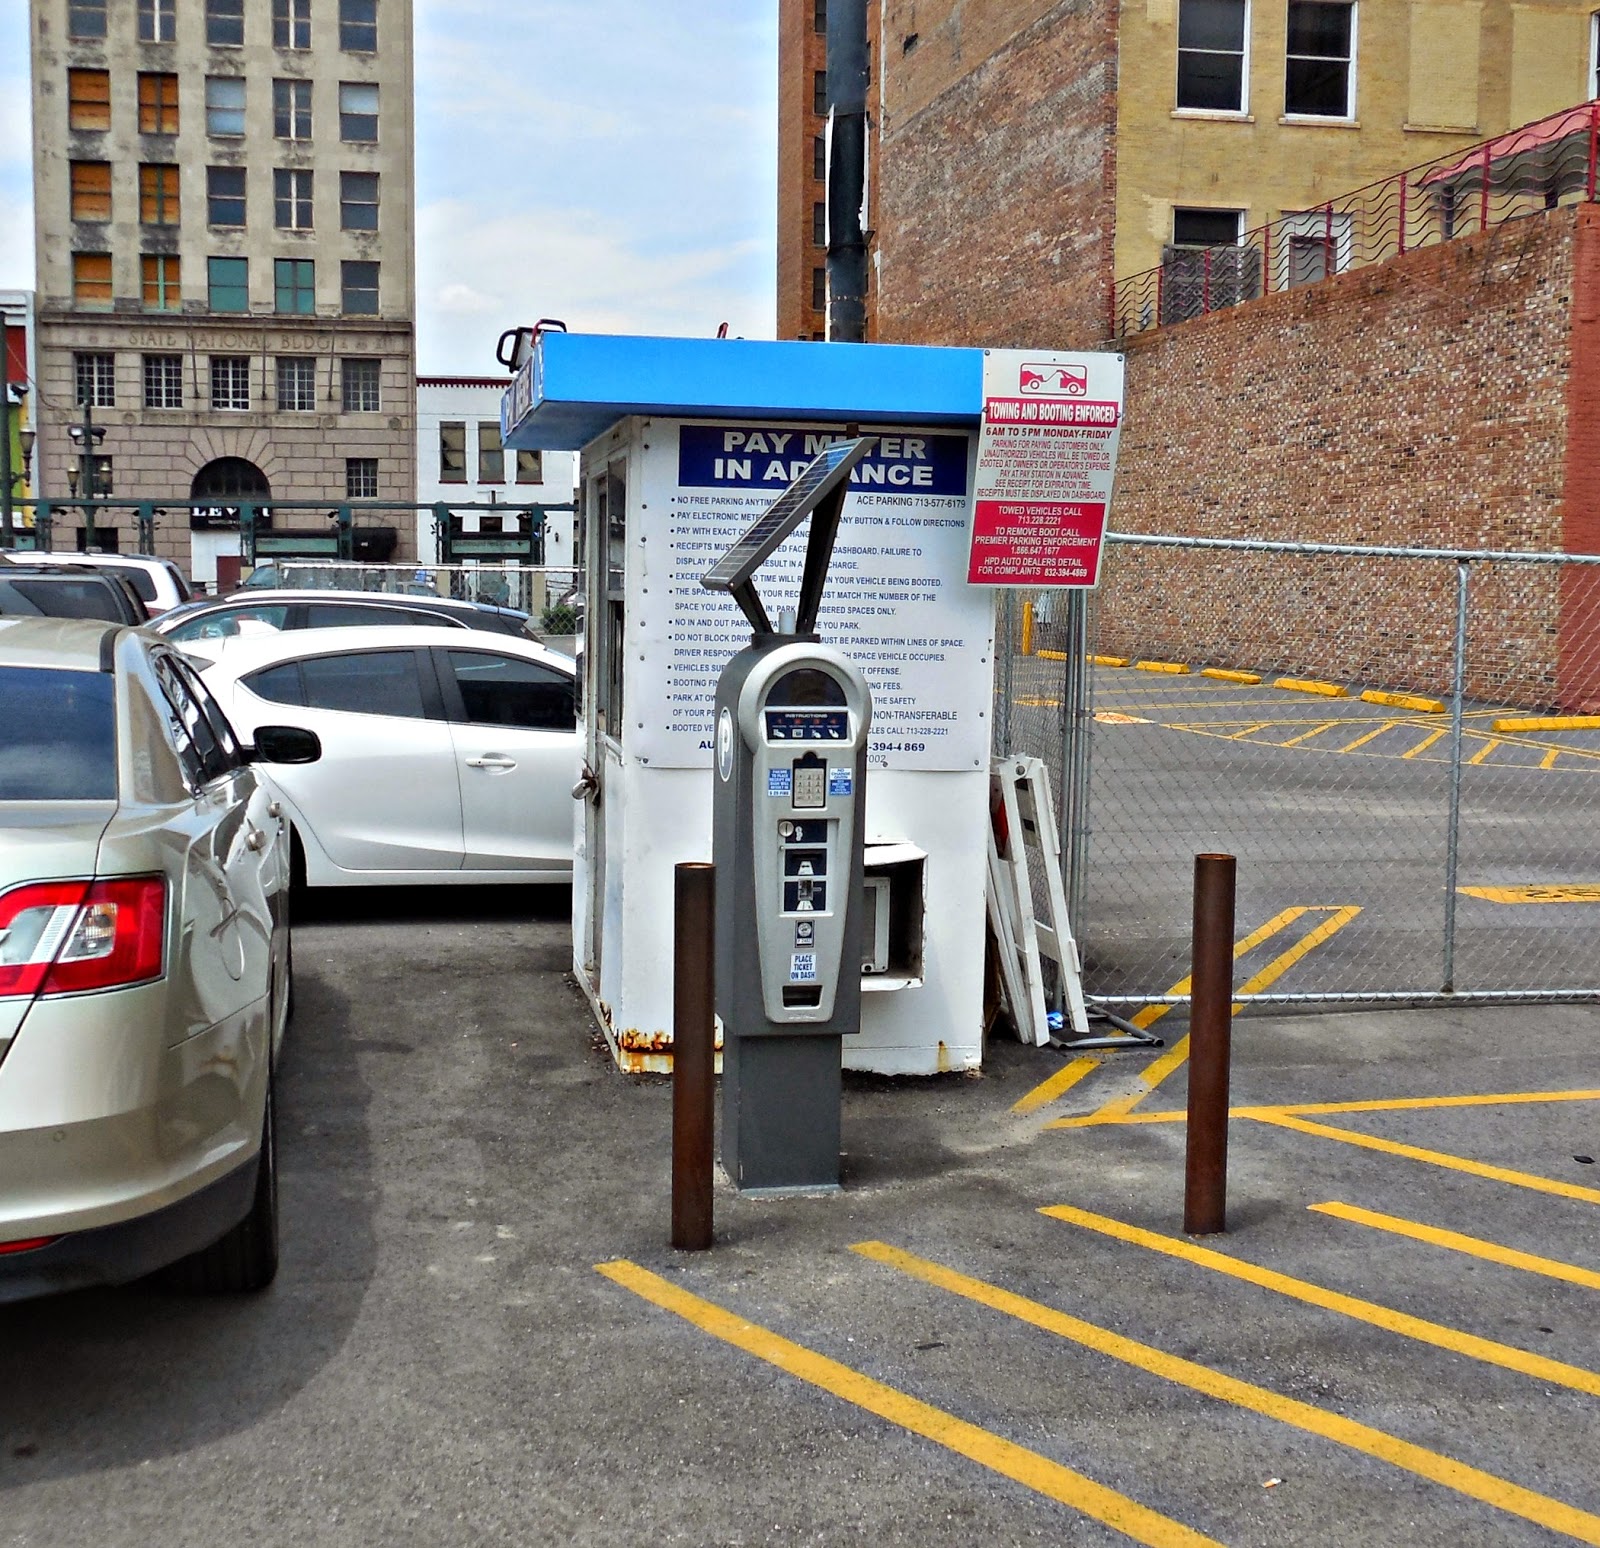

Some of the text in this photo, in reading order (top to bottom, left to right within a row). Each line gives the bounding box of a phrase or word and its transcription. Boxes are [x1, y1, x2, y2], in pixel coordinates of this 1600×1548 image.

[989, 402, 1115, 423] TOWING AND BOOTING ENFORCED
[1008, 428, 1018, 436] TO
[1043, 429, 1112, 439] MONDAY-FRIDAY
[724, 432, 926, 459] PAY MER
[992, 440, 1017, 448] PARKING
[1031, 441, 1051, 449] PAYING
[1054, 442, 1088, 450] CUSTOMERS
[984, 450, 1027, 458] UNAUTHORIZED
[1029, 451, 1056, 459] VEHICLES
[1072, 452, 1079, 460] BE
[1081, 452, 1100, 460] TOWED
[980, 459, 1003, 467] BOOTED
[1085, 462, 1110, 470] EXPENSE
[714, 458, 934, 486] IN ADANCE
[1011, 470, 1018, 478] AT
[1020, 470, 1030, 478] PAY
[1031, 470, 1054, 478] STATION
[1008, 480, 1030, 488] RECEIPT
[1032, 480, 1043, 488] FOR
[1045, 481, 1076, 489] EXPIRATION
[977, 489, 1004, 497] RECEIPTS
[1022, 490, 1031, 498] BE
[1032, 490, 1060, 498] DISPLAYED
[678, 496, 688, 504] NO
[711, 497, 743, 505] PARKING
[857, 496, 874, 505] ACE
[876, 497, 912, 506] PARKING
[998, 506, 1082, 516] TOWED VEHICLES CALL
[693, 512, 739, 520] ELECTRONIC
[892, 518, 921, 526] FOLLOW
[923, 519, 966, 527] DIRECTIONS
[996, 527, 1079, 536] TO REMOVE BOOT CALL
[975, 536, 1097, 546] PREMIER PARKING ENFORCEMENT
[676, 542, 712, 550] RECEIPTS
[676, 557, 706, 565] DISPLAY
[985, 557, 999, 565] HPD
[1001, 558, 1020, 566] AUTO
[1023, 558, 1056, 566] DEALERS
[978, 566, 993, 574] FOR
[995, 567, 1040, 576] COMPLAINTS
[856, 577, 886, 585] VEHICLE
[864, 592, 877, 600] THE
[911, 593, 920, 601] OF
[701, 603, 716, 611] YOU
[714, 619, 729, 627] OUT
[704, 634, 729, 642] BLOCK
[851, 637, 879, 645] PARKED
[941, 639, 964, 647] SPACE.
[874, 711, 957, 720] NON-TRANSFERABLE
